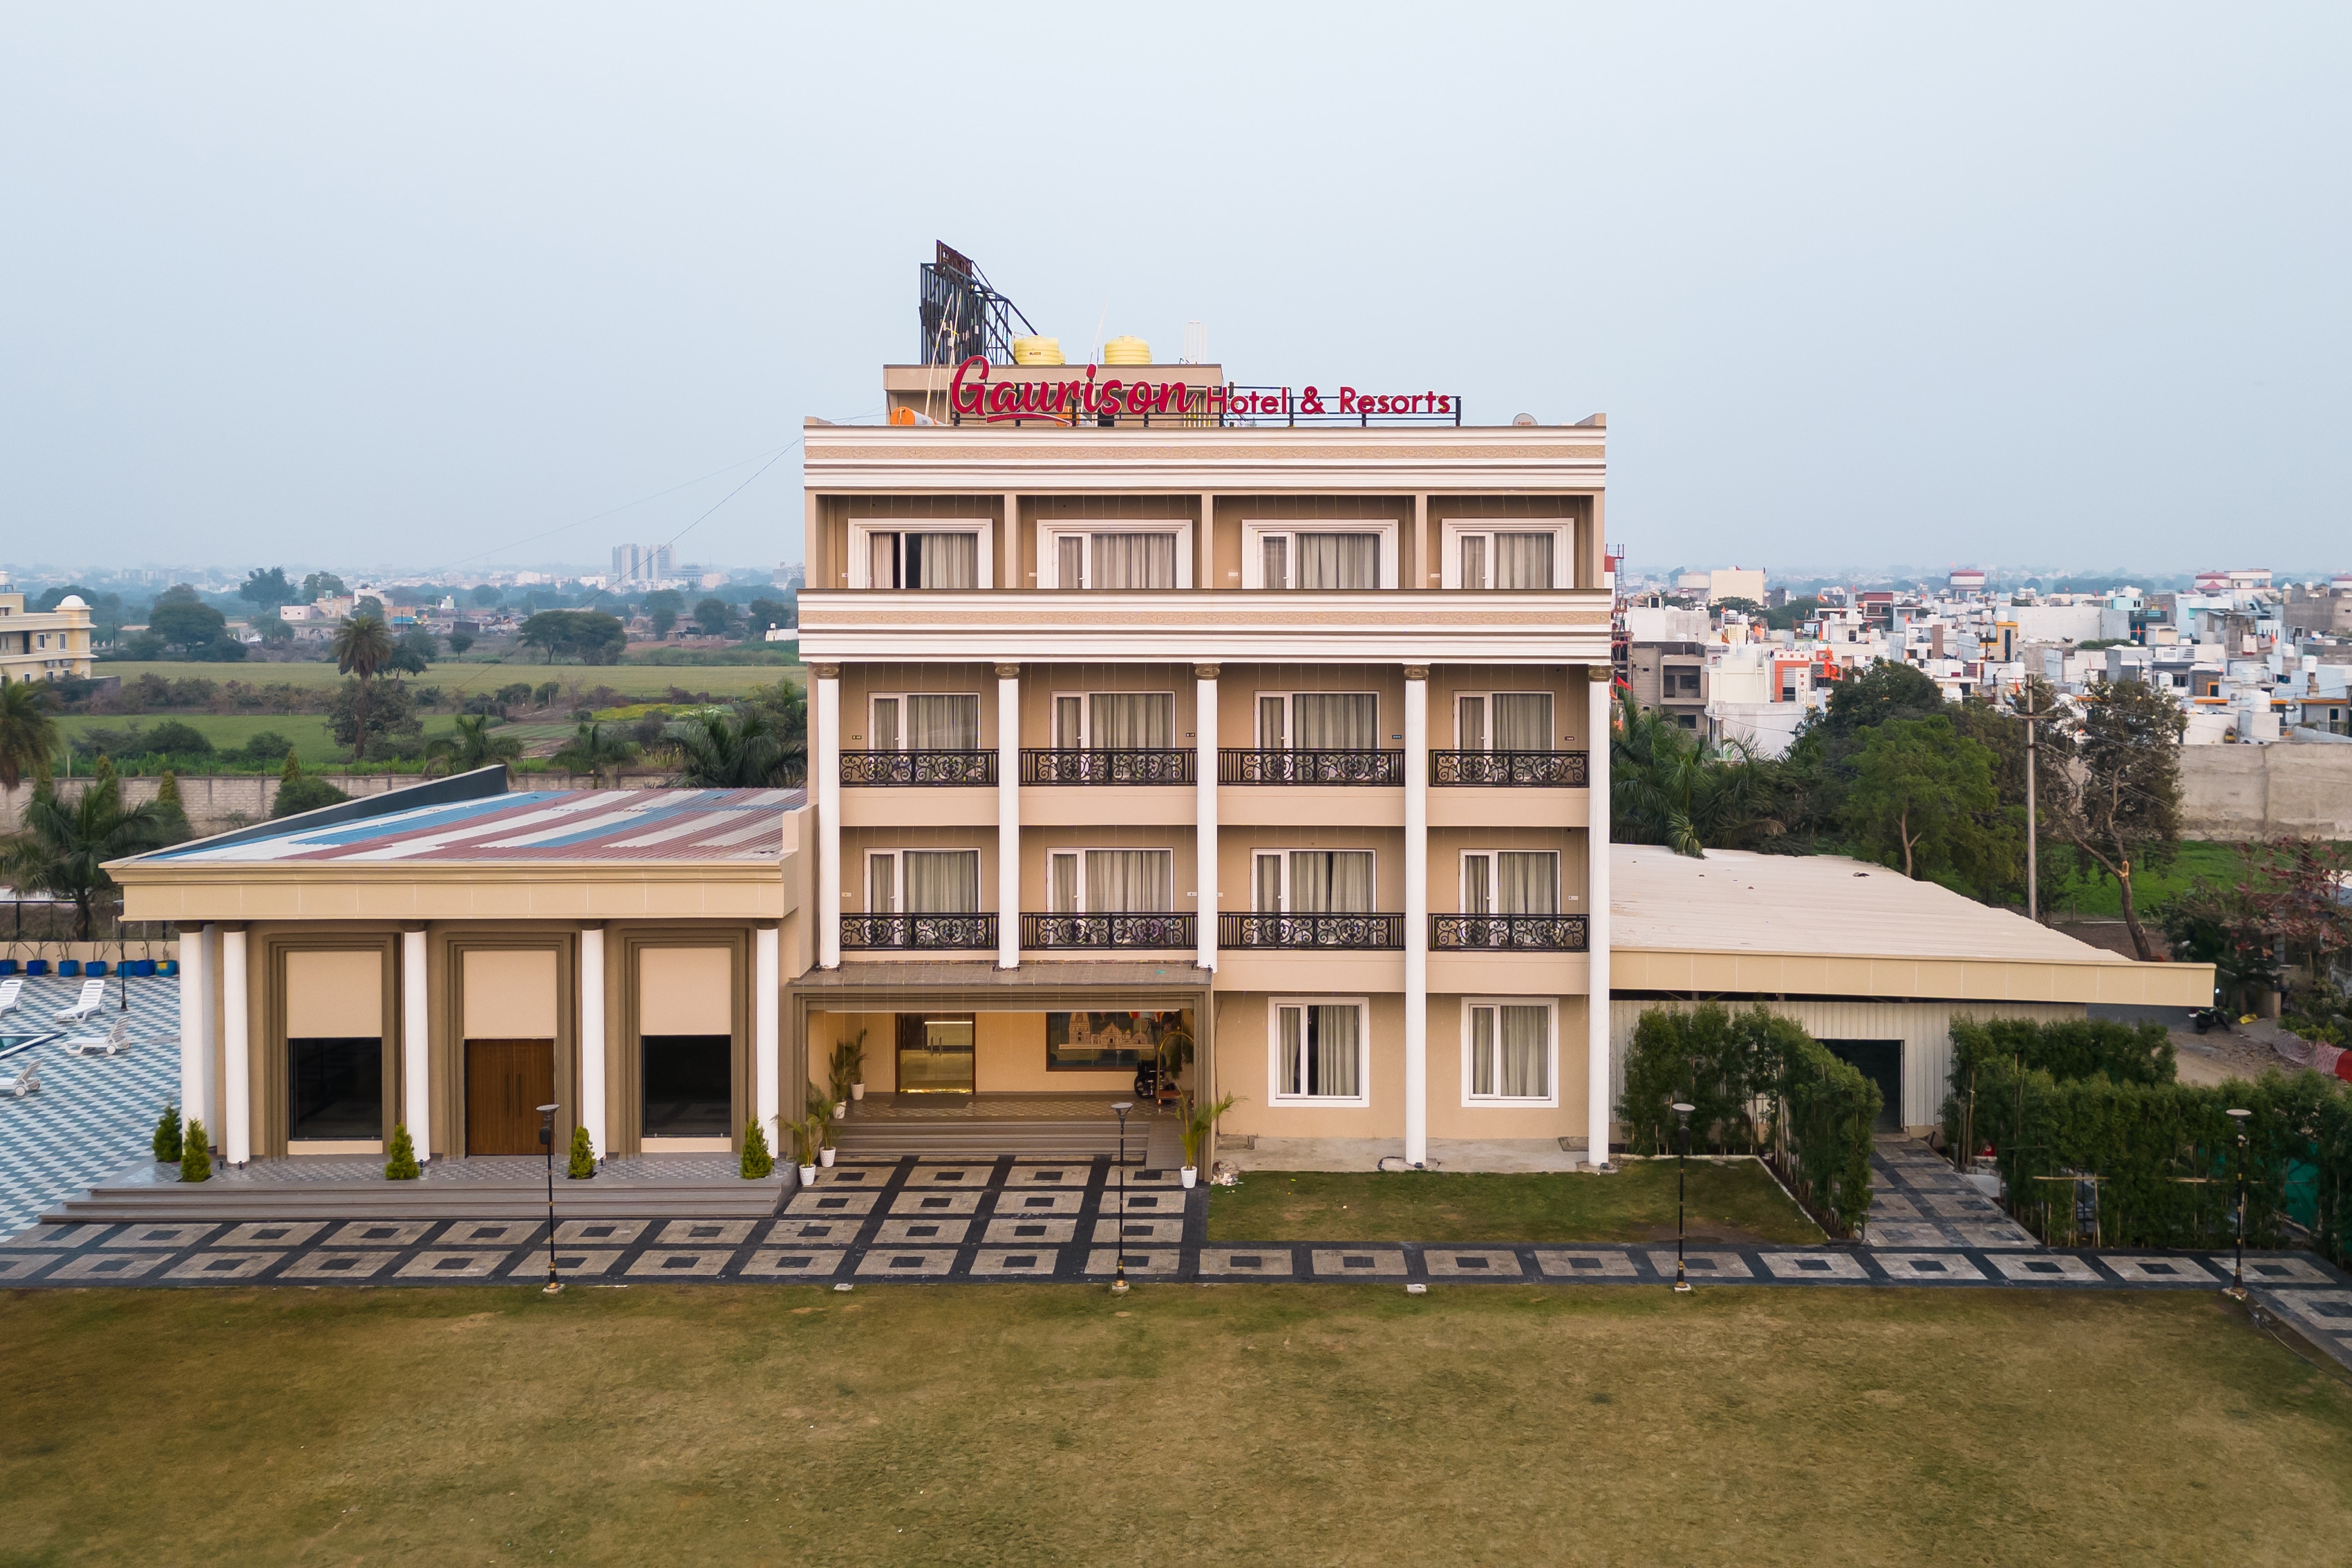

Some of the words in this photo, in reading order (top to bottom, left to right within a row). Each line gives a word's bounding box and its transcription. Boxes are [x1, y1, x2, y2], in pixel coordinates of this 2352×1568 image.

[950, 355, 1198, 417] Gaurison
[1207, 386, 1288, 415] Hotel
[1300, 386, 1324, 415] &
[1339, 386, 1450, 415] Resorts
